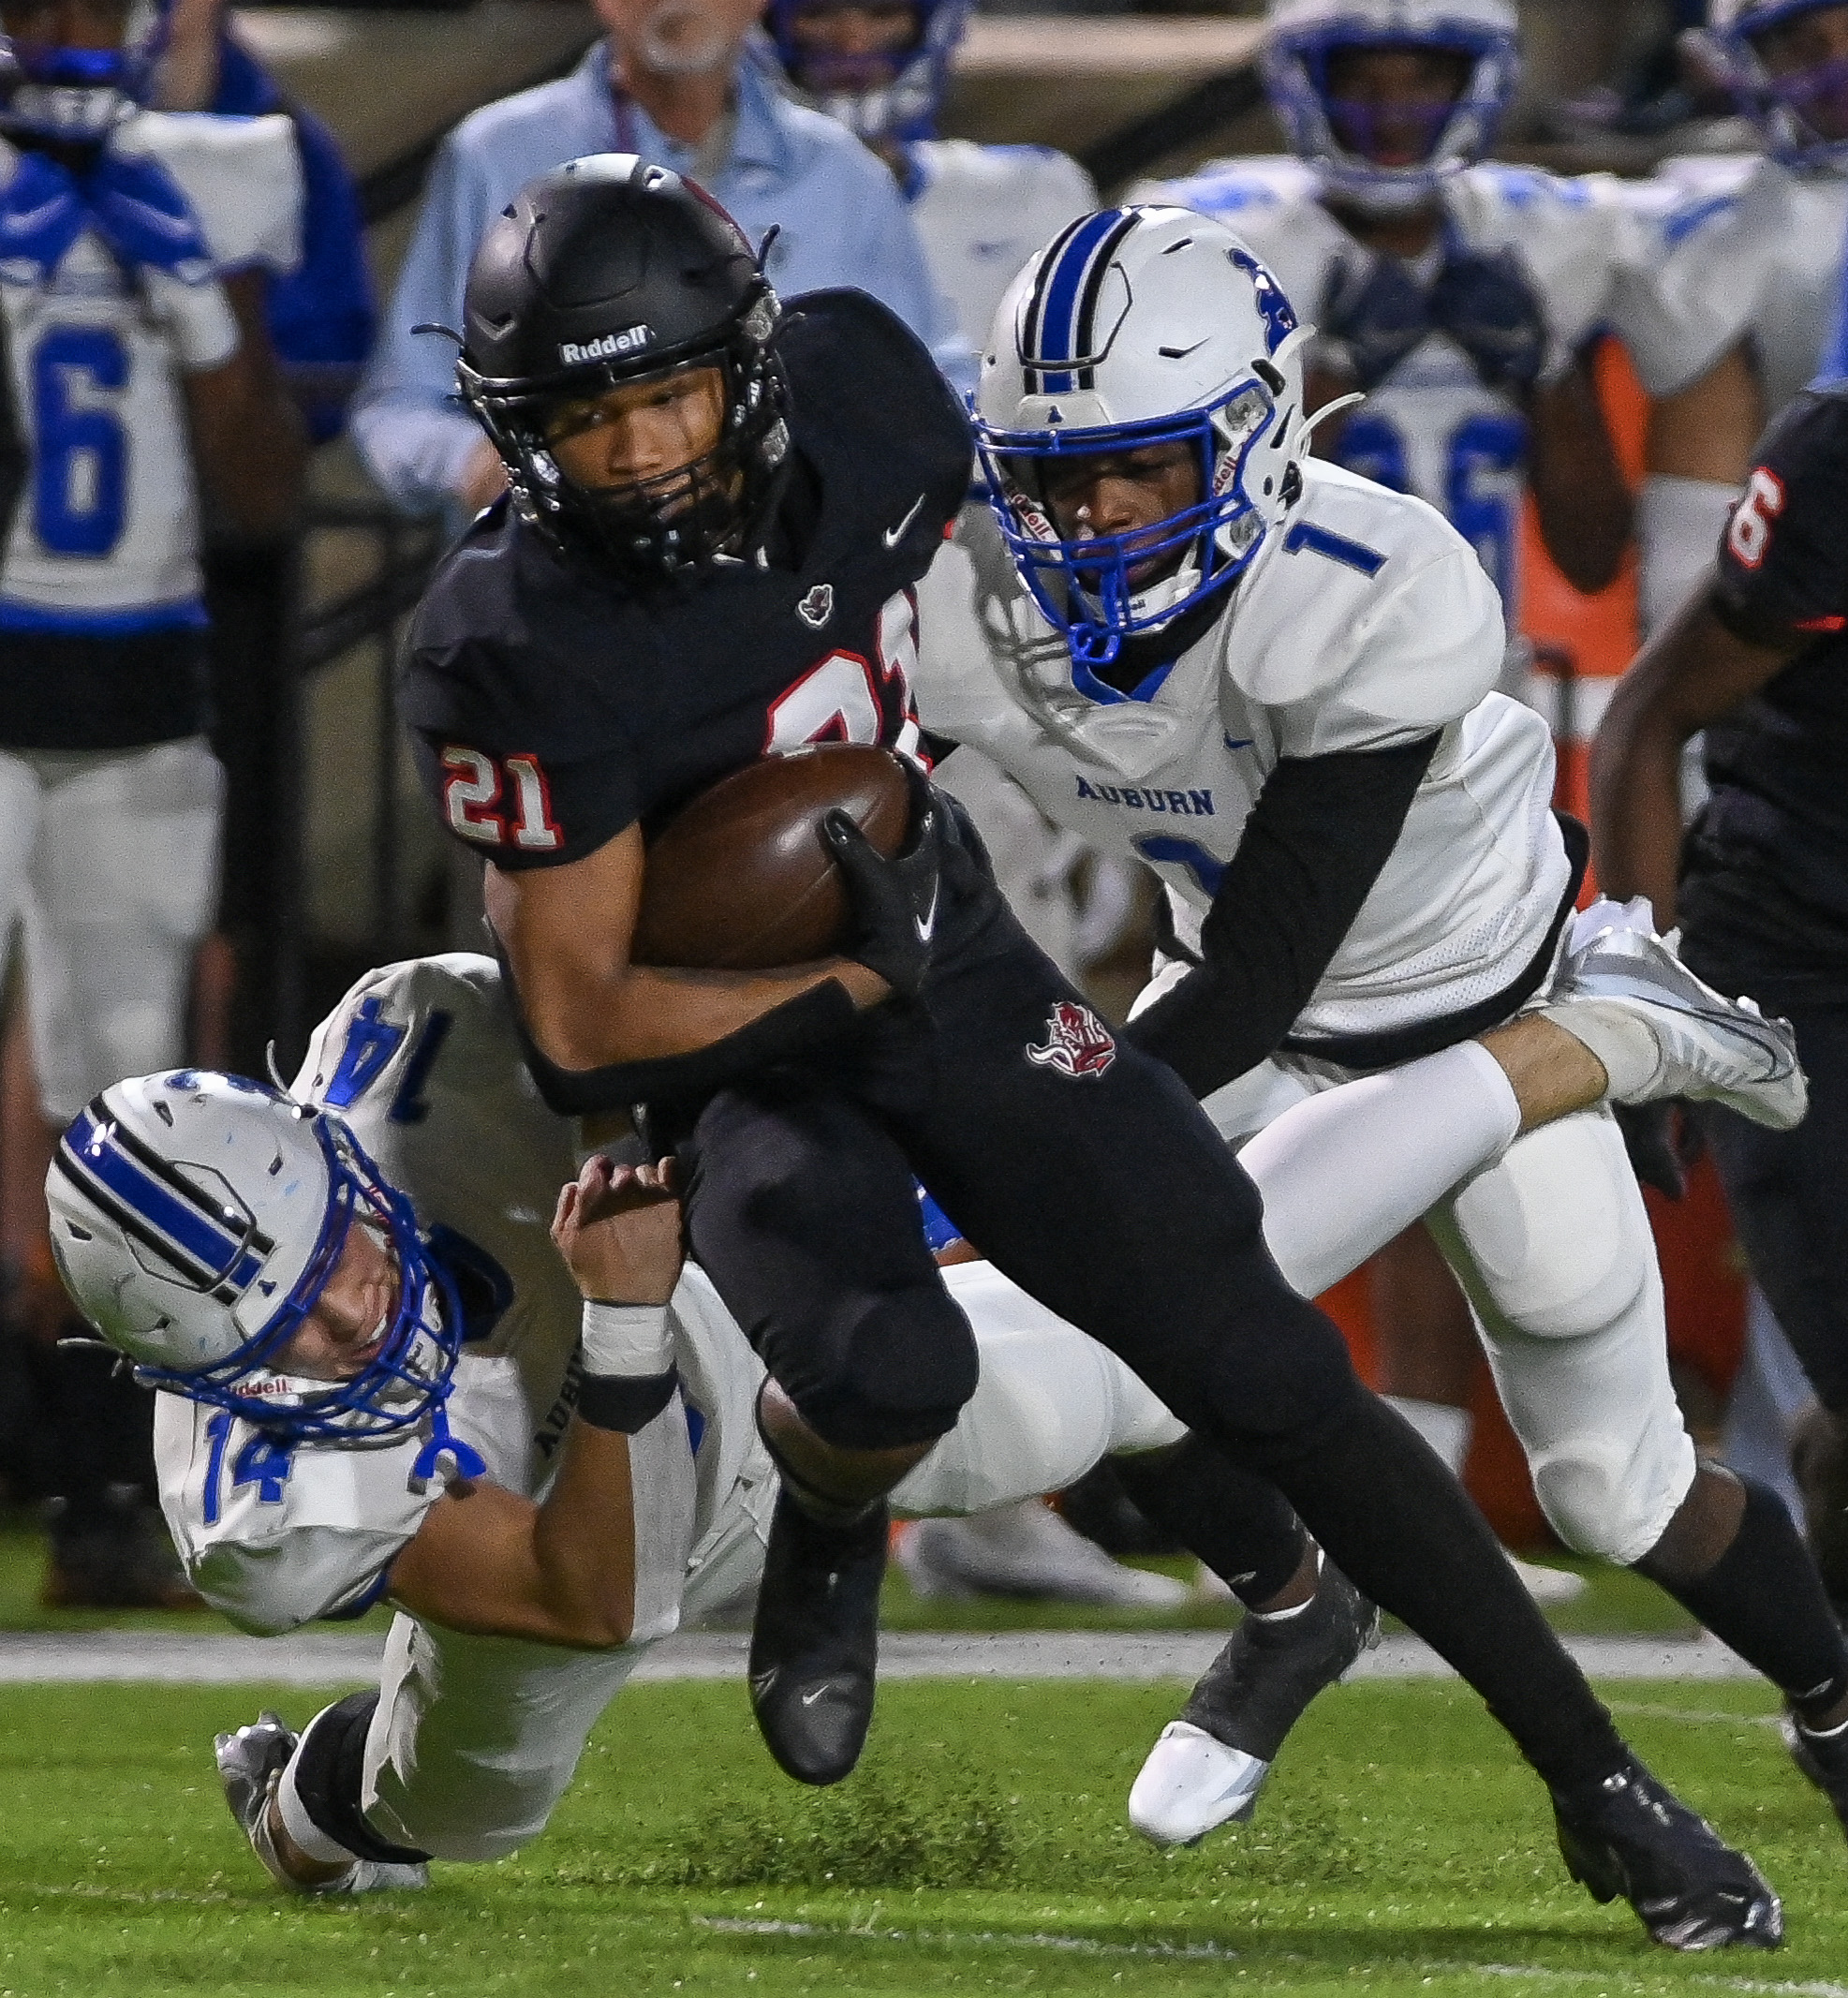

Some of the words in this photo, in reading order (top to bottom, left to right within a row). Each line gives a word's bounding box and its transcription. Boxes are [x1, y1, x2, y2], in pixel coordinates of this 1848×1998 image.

[562, 324, 648, 363] Riddell
[32, 321, 129, 559] 6
[1282, 520, 1389, 579] 1
[1728, 466, 1784, 569] 6
[443, 744, 565, 851] 21
[1075, 774, 1216, 816] AUBURN
[322, 997, 453, 1125] 14
[203, 1414, 291, 1525] 14
